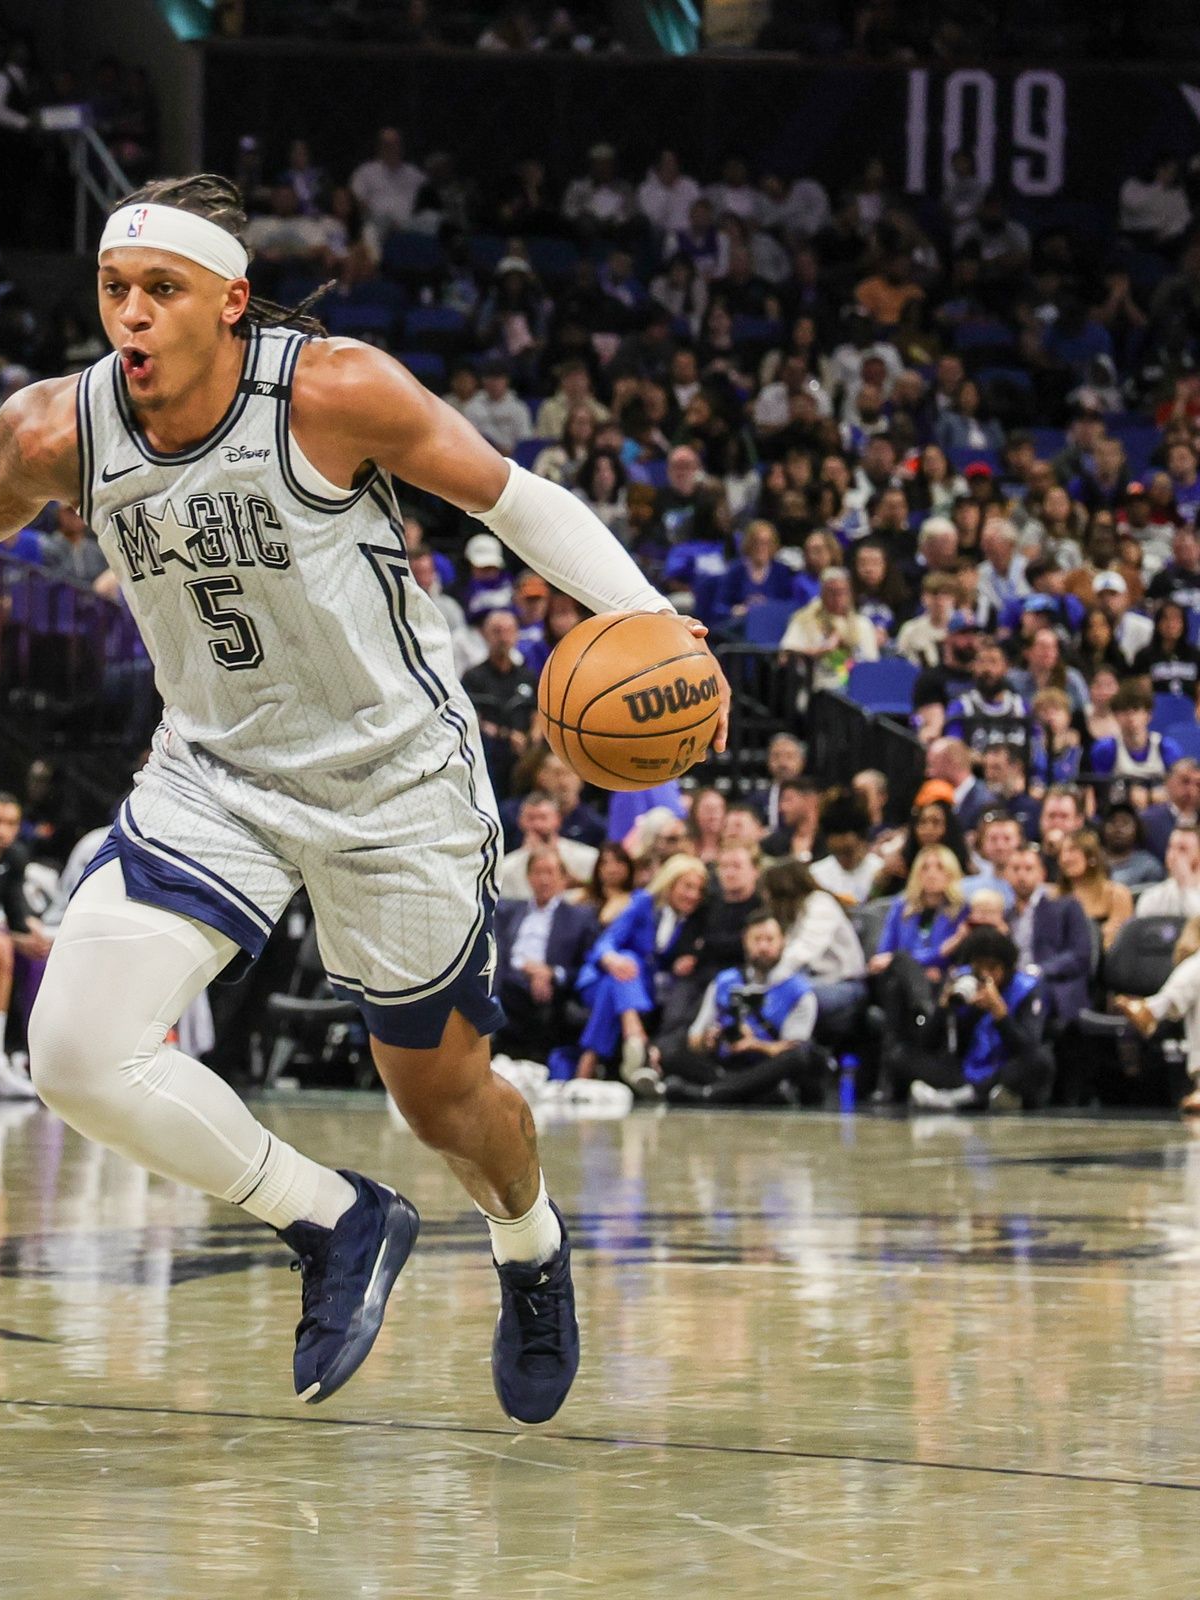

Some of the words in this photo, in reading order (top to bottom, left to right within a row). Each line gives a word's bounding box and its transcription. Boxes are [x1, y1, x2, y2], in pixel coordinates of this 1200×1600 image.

[906, 69, 1066, 197] 109
[255, 382, 275, 395] PW
[184, 574, 265, 671] 5
[621, 674, 720, 724] Wilson
